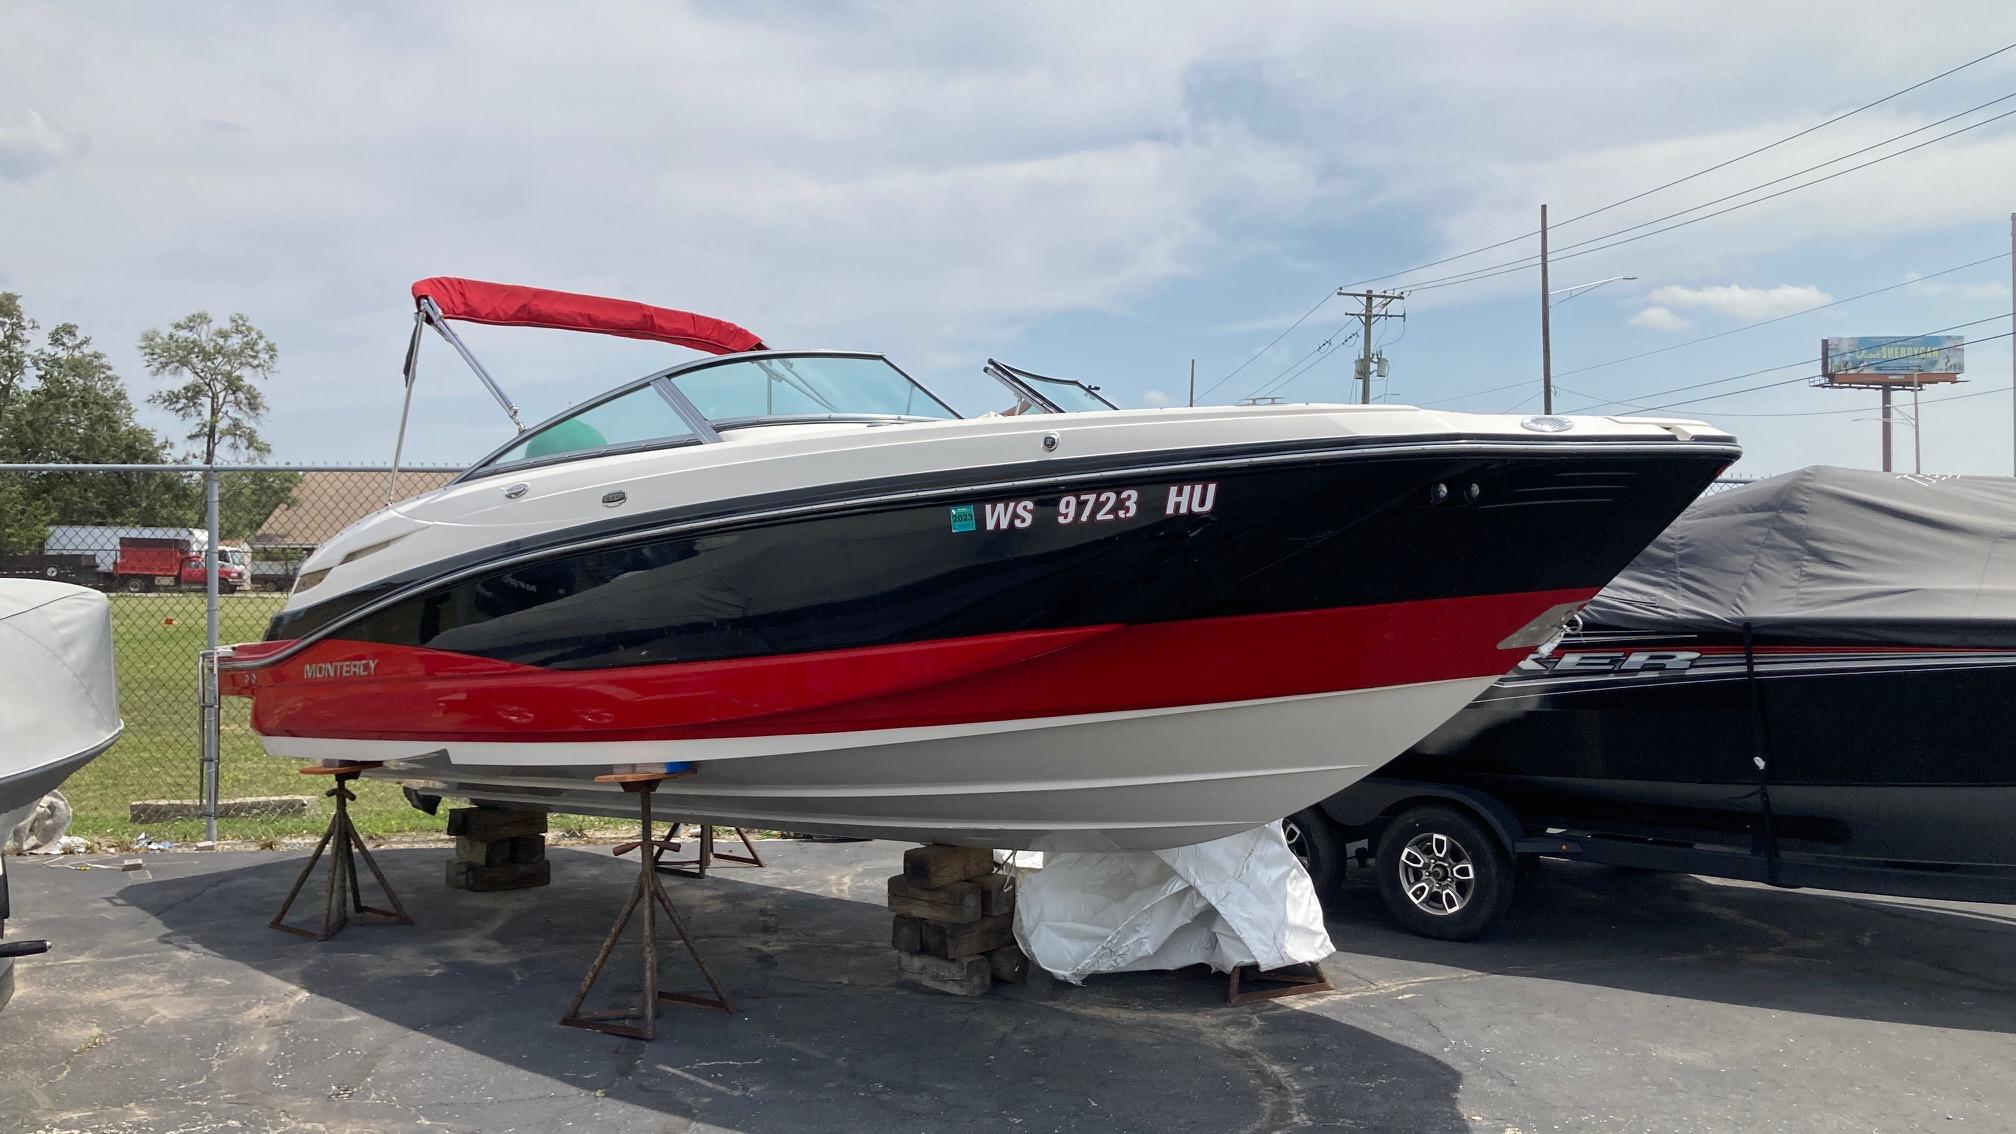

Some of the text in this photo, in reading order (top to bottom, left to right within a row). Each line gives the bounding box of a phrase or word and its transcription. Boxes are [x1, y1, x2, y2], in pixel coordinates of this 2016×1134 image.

[984, 482, 1218, 531] WS 9723 HU
[952, 513, 974, 523] 2023
[303, 659, 379, 679] MONTEREY
